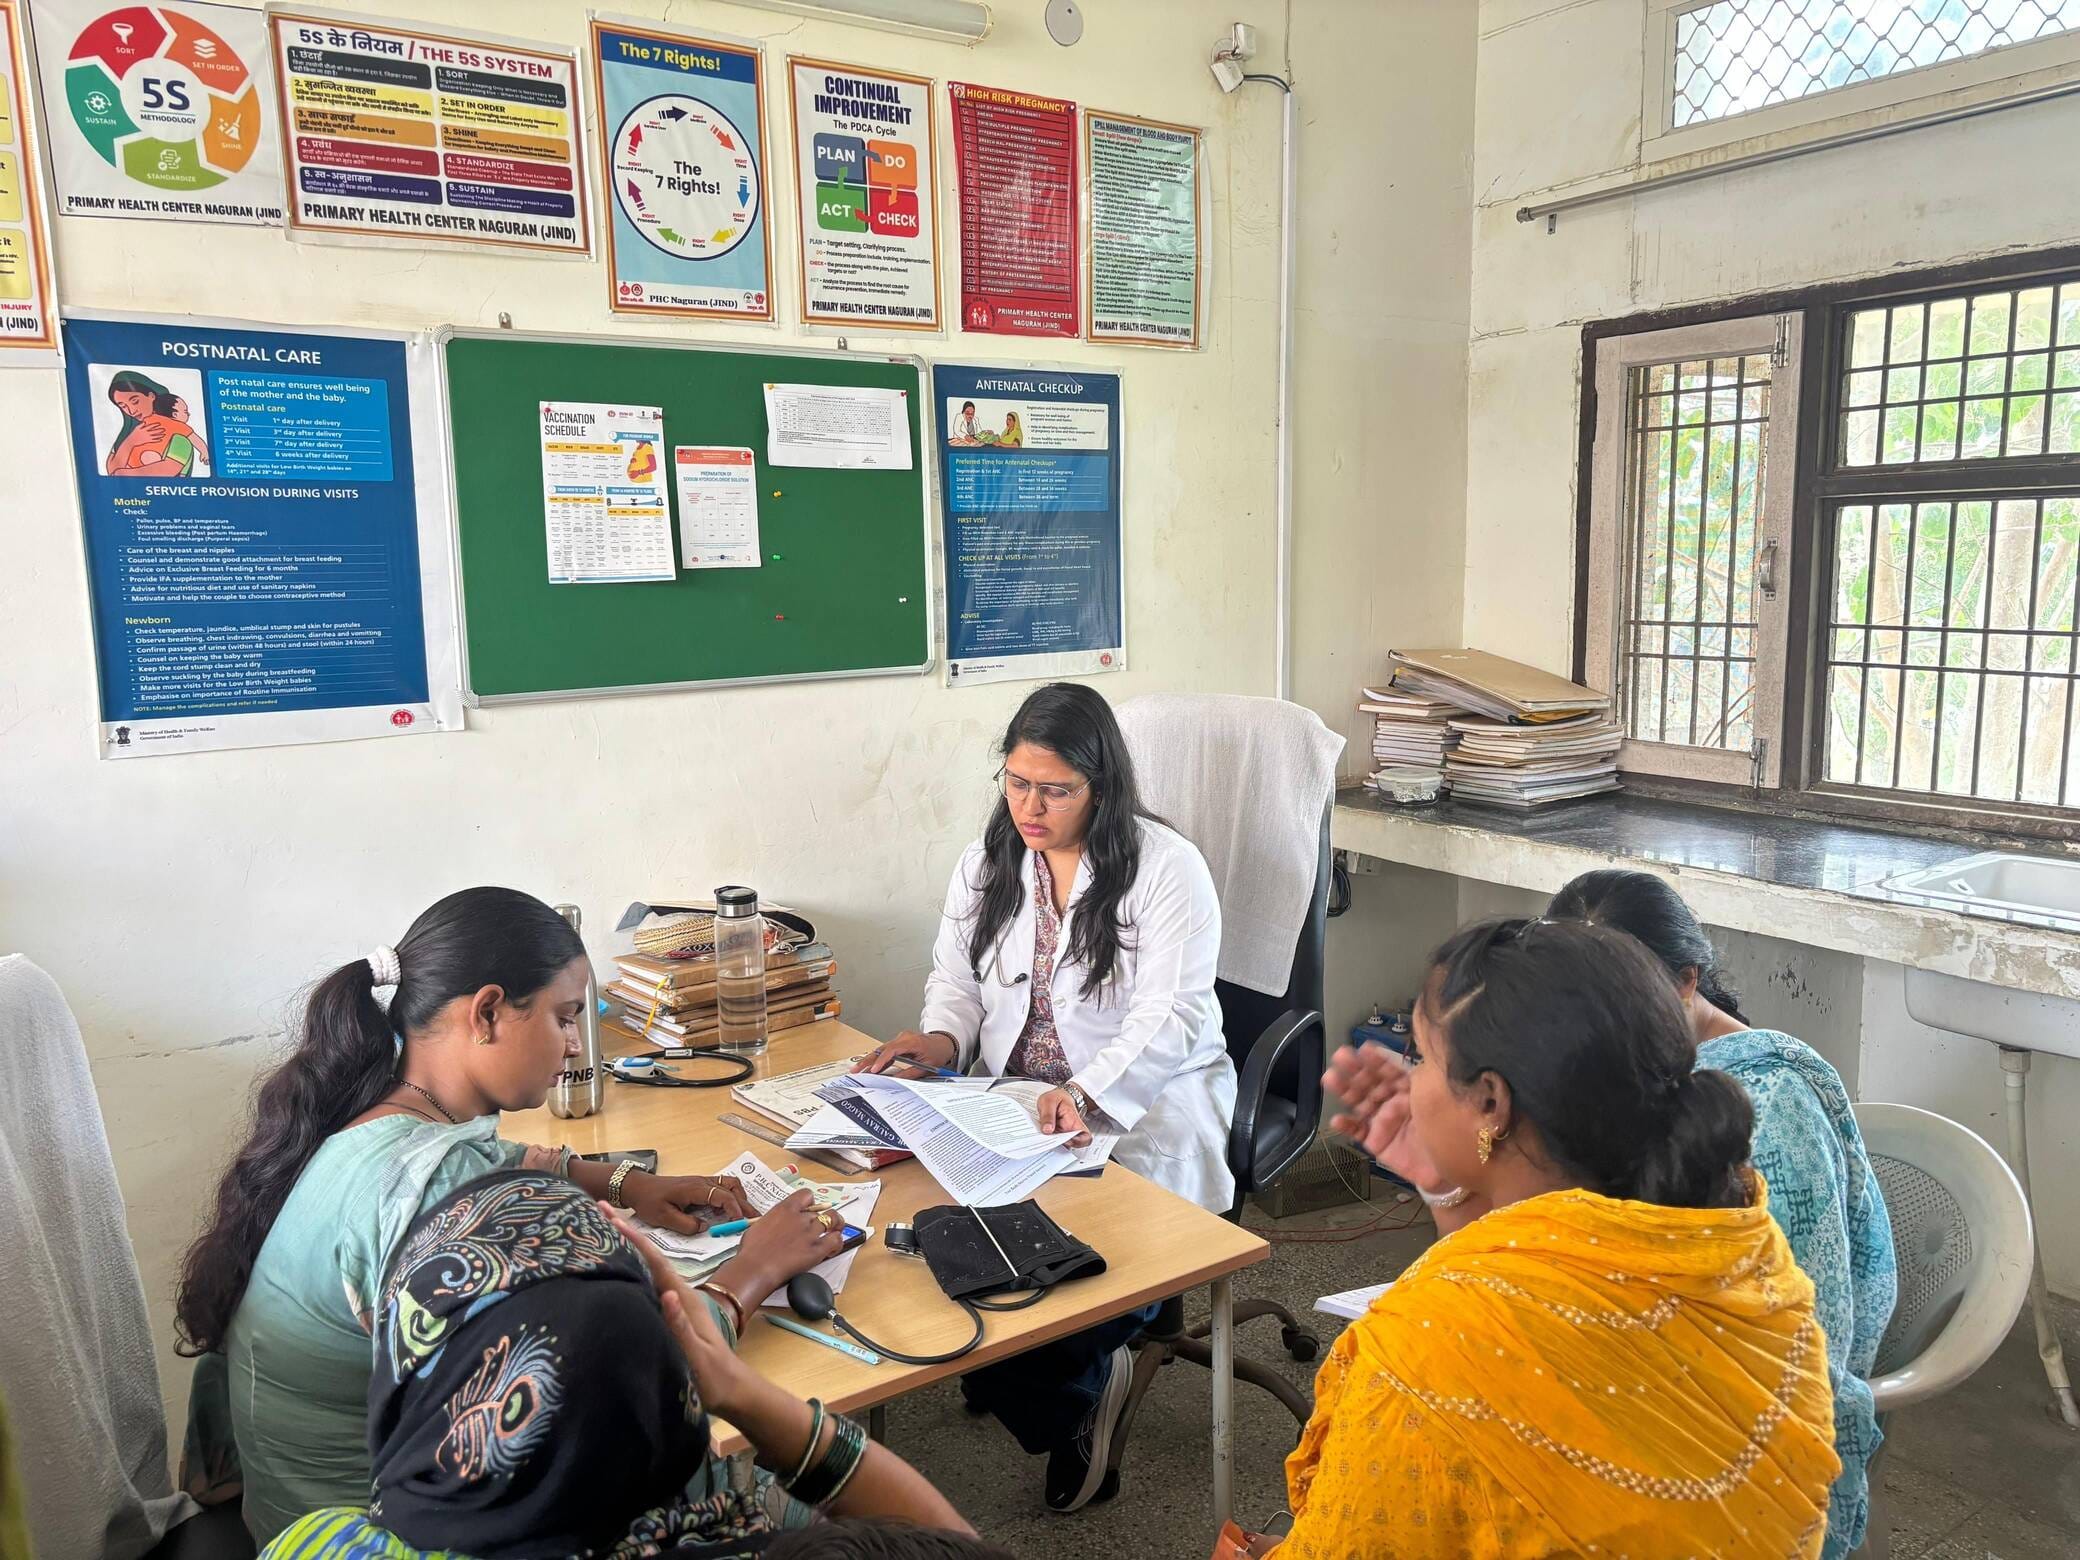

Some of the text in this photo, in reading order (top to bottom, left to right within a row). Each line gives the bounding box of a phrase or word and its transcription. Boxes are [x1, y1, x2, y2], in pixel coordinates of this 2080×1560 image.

[116, 46, 136, 56] SORT
[300, 29, 323, 44] 5S
[327, 28, 346, 47] के
[351, 31, 403, 56] नियम
[419, 46, 454, 64] THE
[458, 52, 480, 66] 5S
[485, 56, 552, 78] SYSTEM
[619, 41, 720, 71] The 7 Rights!
[207, 62, 215, 70] IN
[216, 64, 240, 72] ORDER
[438, 68, 468, 79] 1. SORT
[142, 77, 190, 111] 5S
[825, 76, 900, 104] CONTINUAL
[450, 99, 464, 108] SET
[467, 101, 476, 109] IN
[477, 103, 505, 113] ORDER
[966, 88, 989, 100] HIGH
[992, 93, 1012, 104] RISK
[1015, 96, 1066, 113] PREGNANCY
[814, 94, 911, 125] IMPROVEMENT
[85, 116, 117, 126] SUSTAIN
[140, 113, 196, 124] METHODOLOGY
[452, 128, 478, 138] SHINE
[833, 120, 896, 137] The PDCA Cycle
[221, 142, 242, 150] SHINE
[817, 146, 855, 162] PLAN
[446, 156, 515, 170] 4. STANDARDIZE
[674, 160, 702, 175] The
[885, 155, 906, 168] DO
[146, 173, 196, 182] STANDARDIZE
[449, 183, 495, 195] 5. SUSTAIN
[655, 175, 720, 196] 7 Rights!
[68, 196, 115, 209] PRIMARY
[118, 198, 159, 211] HEALTH
[162, 201, 202, 214] CENTER
[205, 203, 252, 217] NAGURAN
[820, 203, 850, 217] ACT
[304, 203, 576, 243] PRIMARY HEALTH CENTER NAGURAN (JIND)
[878, 212, 917, 227] CHECK
[650, 295, 669, 304] PHC
[671, 296, 708, 306] Naguran
[710, 298, 738, 309] (JIND)
[812, 300, 933, 320] PRIMARY HEALTH CENTER NAGURAN (JIND)
[998, 308, 1073, 320] PRIMARY HEALTH CENTER
[6, 317, 38, 332] (JIND)
[1013, 319, 1041, 327] NAGURAN
[1095, 320, 1118, 330] PRIMARY
[1120, 322, 1139, 332] HEALTH
[1140, 324, 1156, 333] CENTER
[1157, 325, 1177, 335] NAGURAN
[162, 341, 321, 365] POSTNATAL CARE
[218, 377, 371, 394] Post natal care ensures well being
[976, 379, 1084, 395] ANTENATAL CHECKUP
[219, 388, 347, 404] of the mother and the baby.
[220, 402, 265, 412] Postnatal
[543, 412, 596, 424] VACCINATION
[544, 425, 587, 436] SCHEDULE
[145, 486, 359, 498] SERVICE PROVISION DURING VISITS
[114, 498, 152, 506] Mother
[125, 616, 171, 624] Newborn
[191, 663, 213, 671] stump
[245, 669, 268, 677] during
[270, 668, 316, 676] breastfeeding
[562, 1067, 594, 1083] PNB
[840, 1100, 865, 1119] MAGGO
